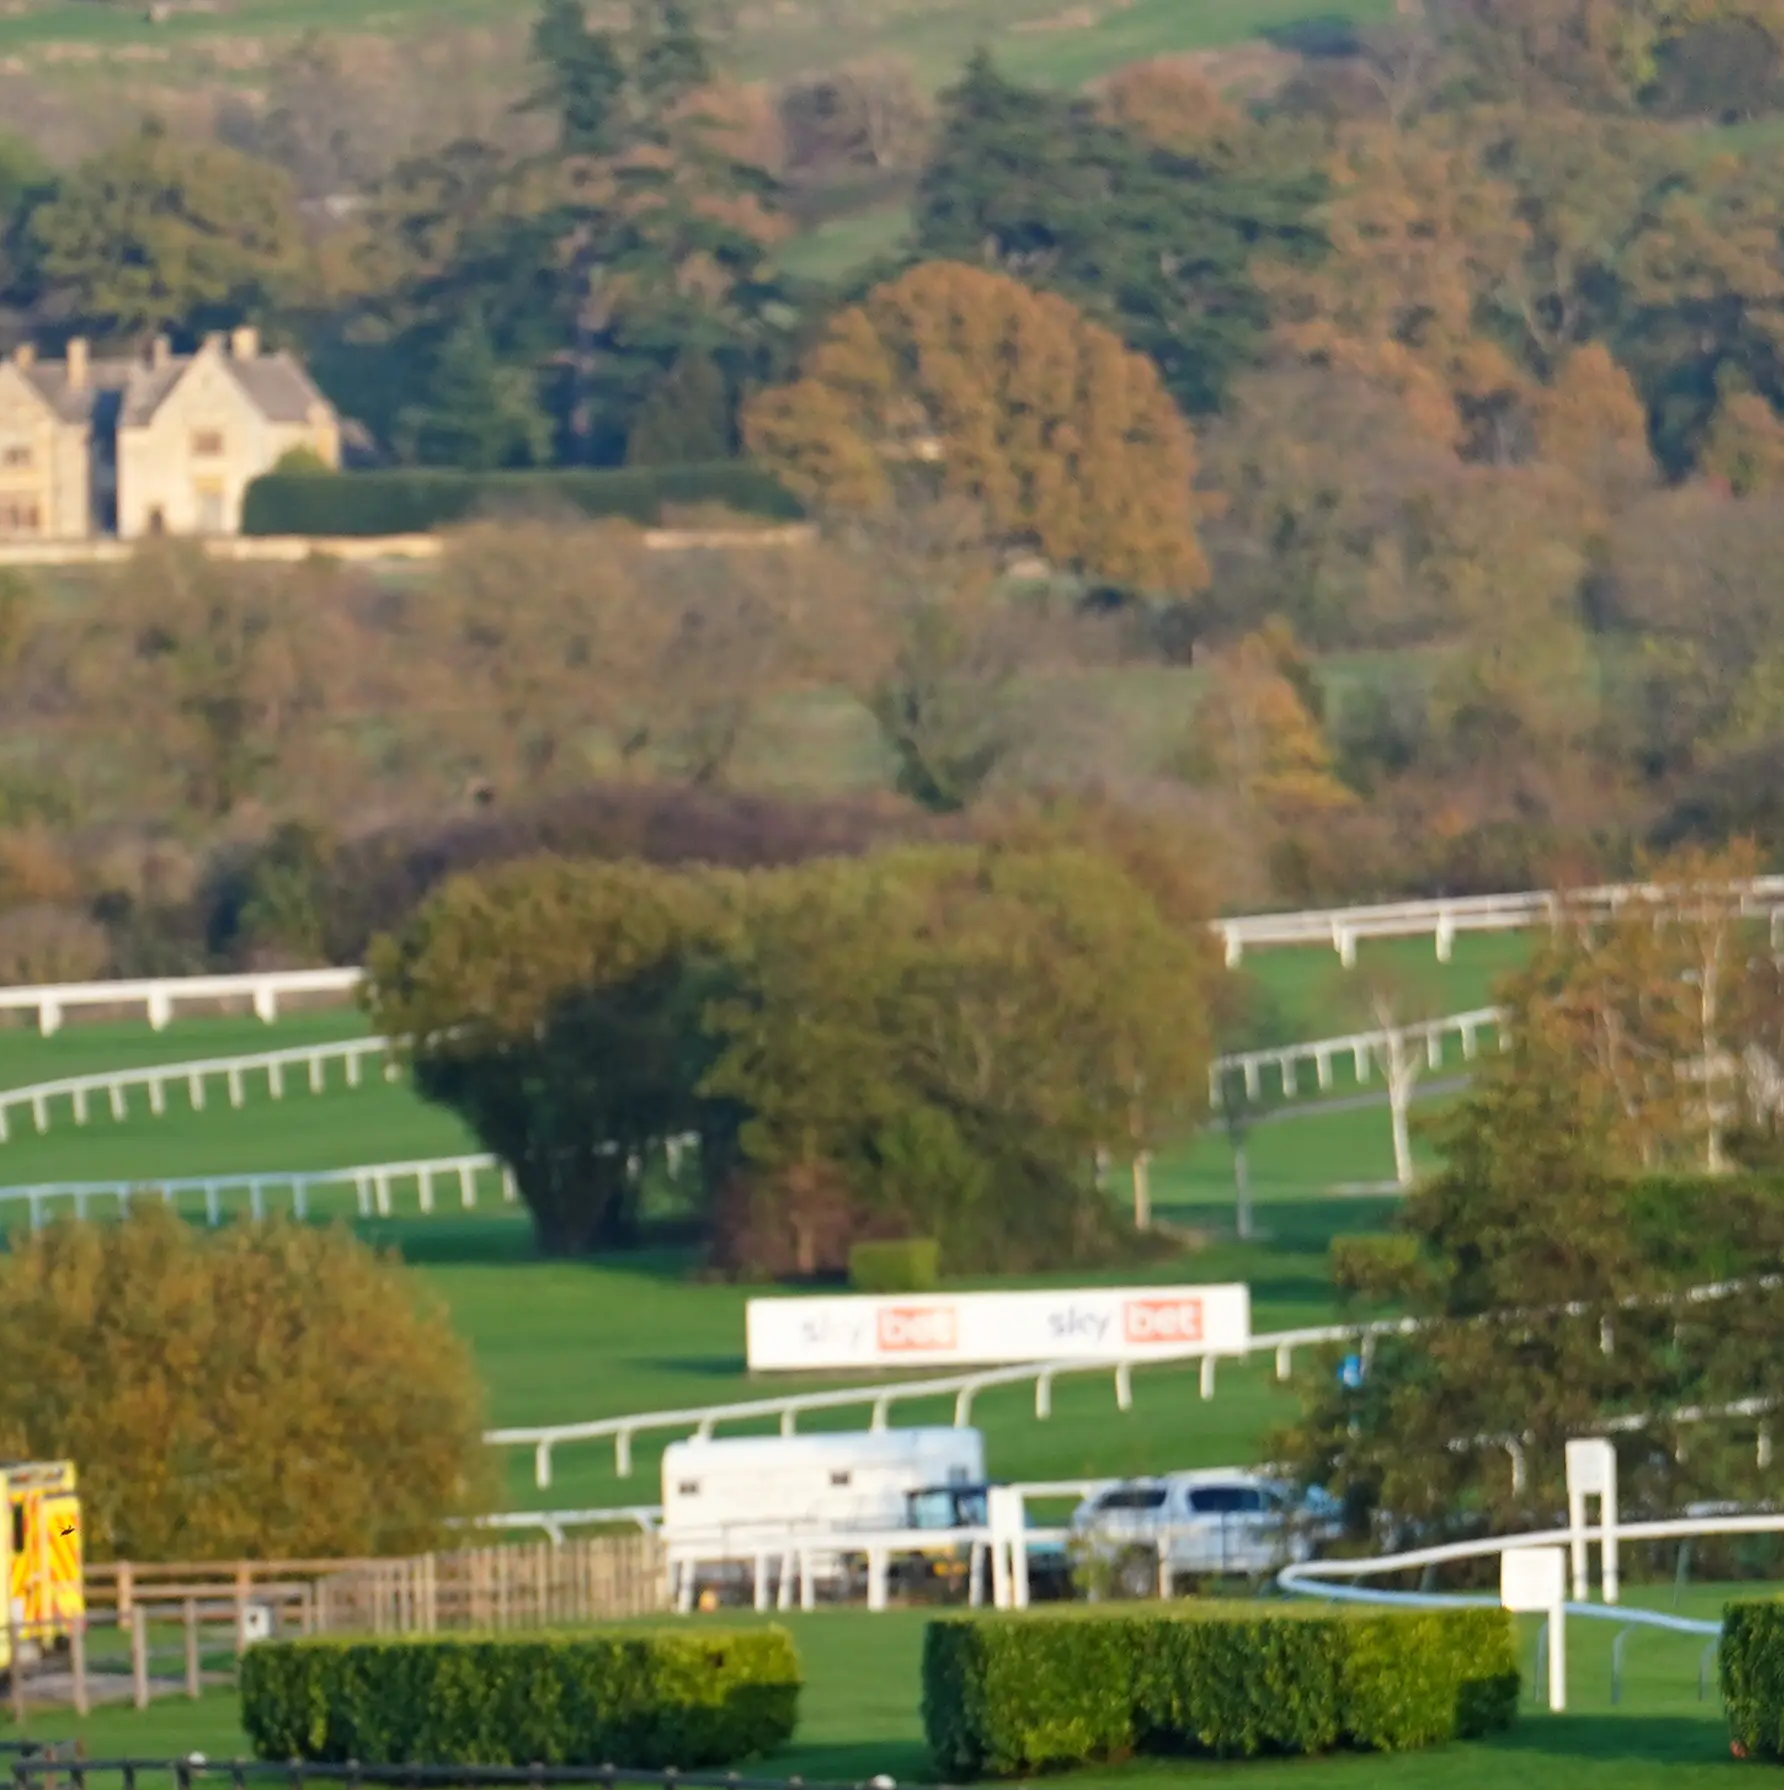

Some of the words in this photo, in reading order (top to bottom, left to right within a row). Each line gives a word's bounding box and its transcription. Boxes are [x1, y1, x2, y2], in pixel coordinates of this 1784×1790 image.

[880, 1309, 955, 1346] bet
[1048, 1305, 1111, 1341] sky
[1126, 1302, 1200, 1338] bet
